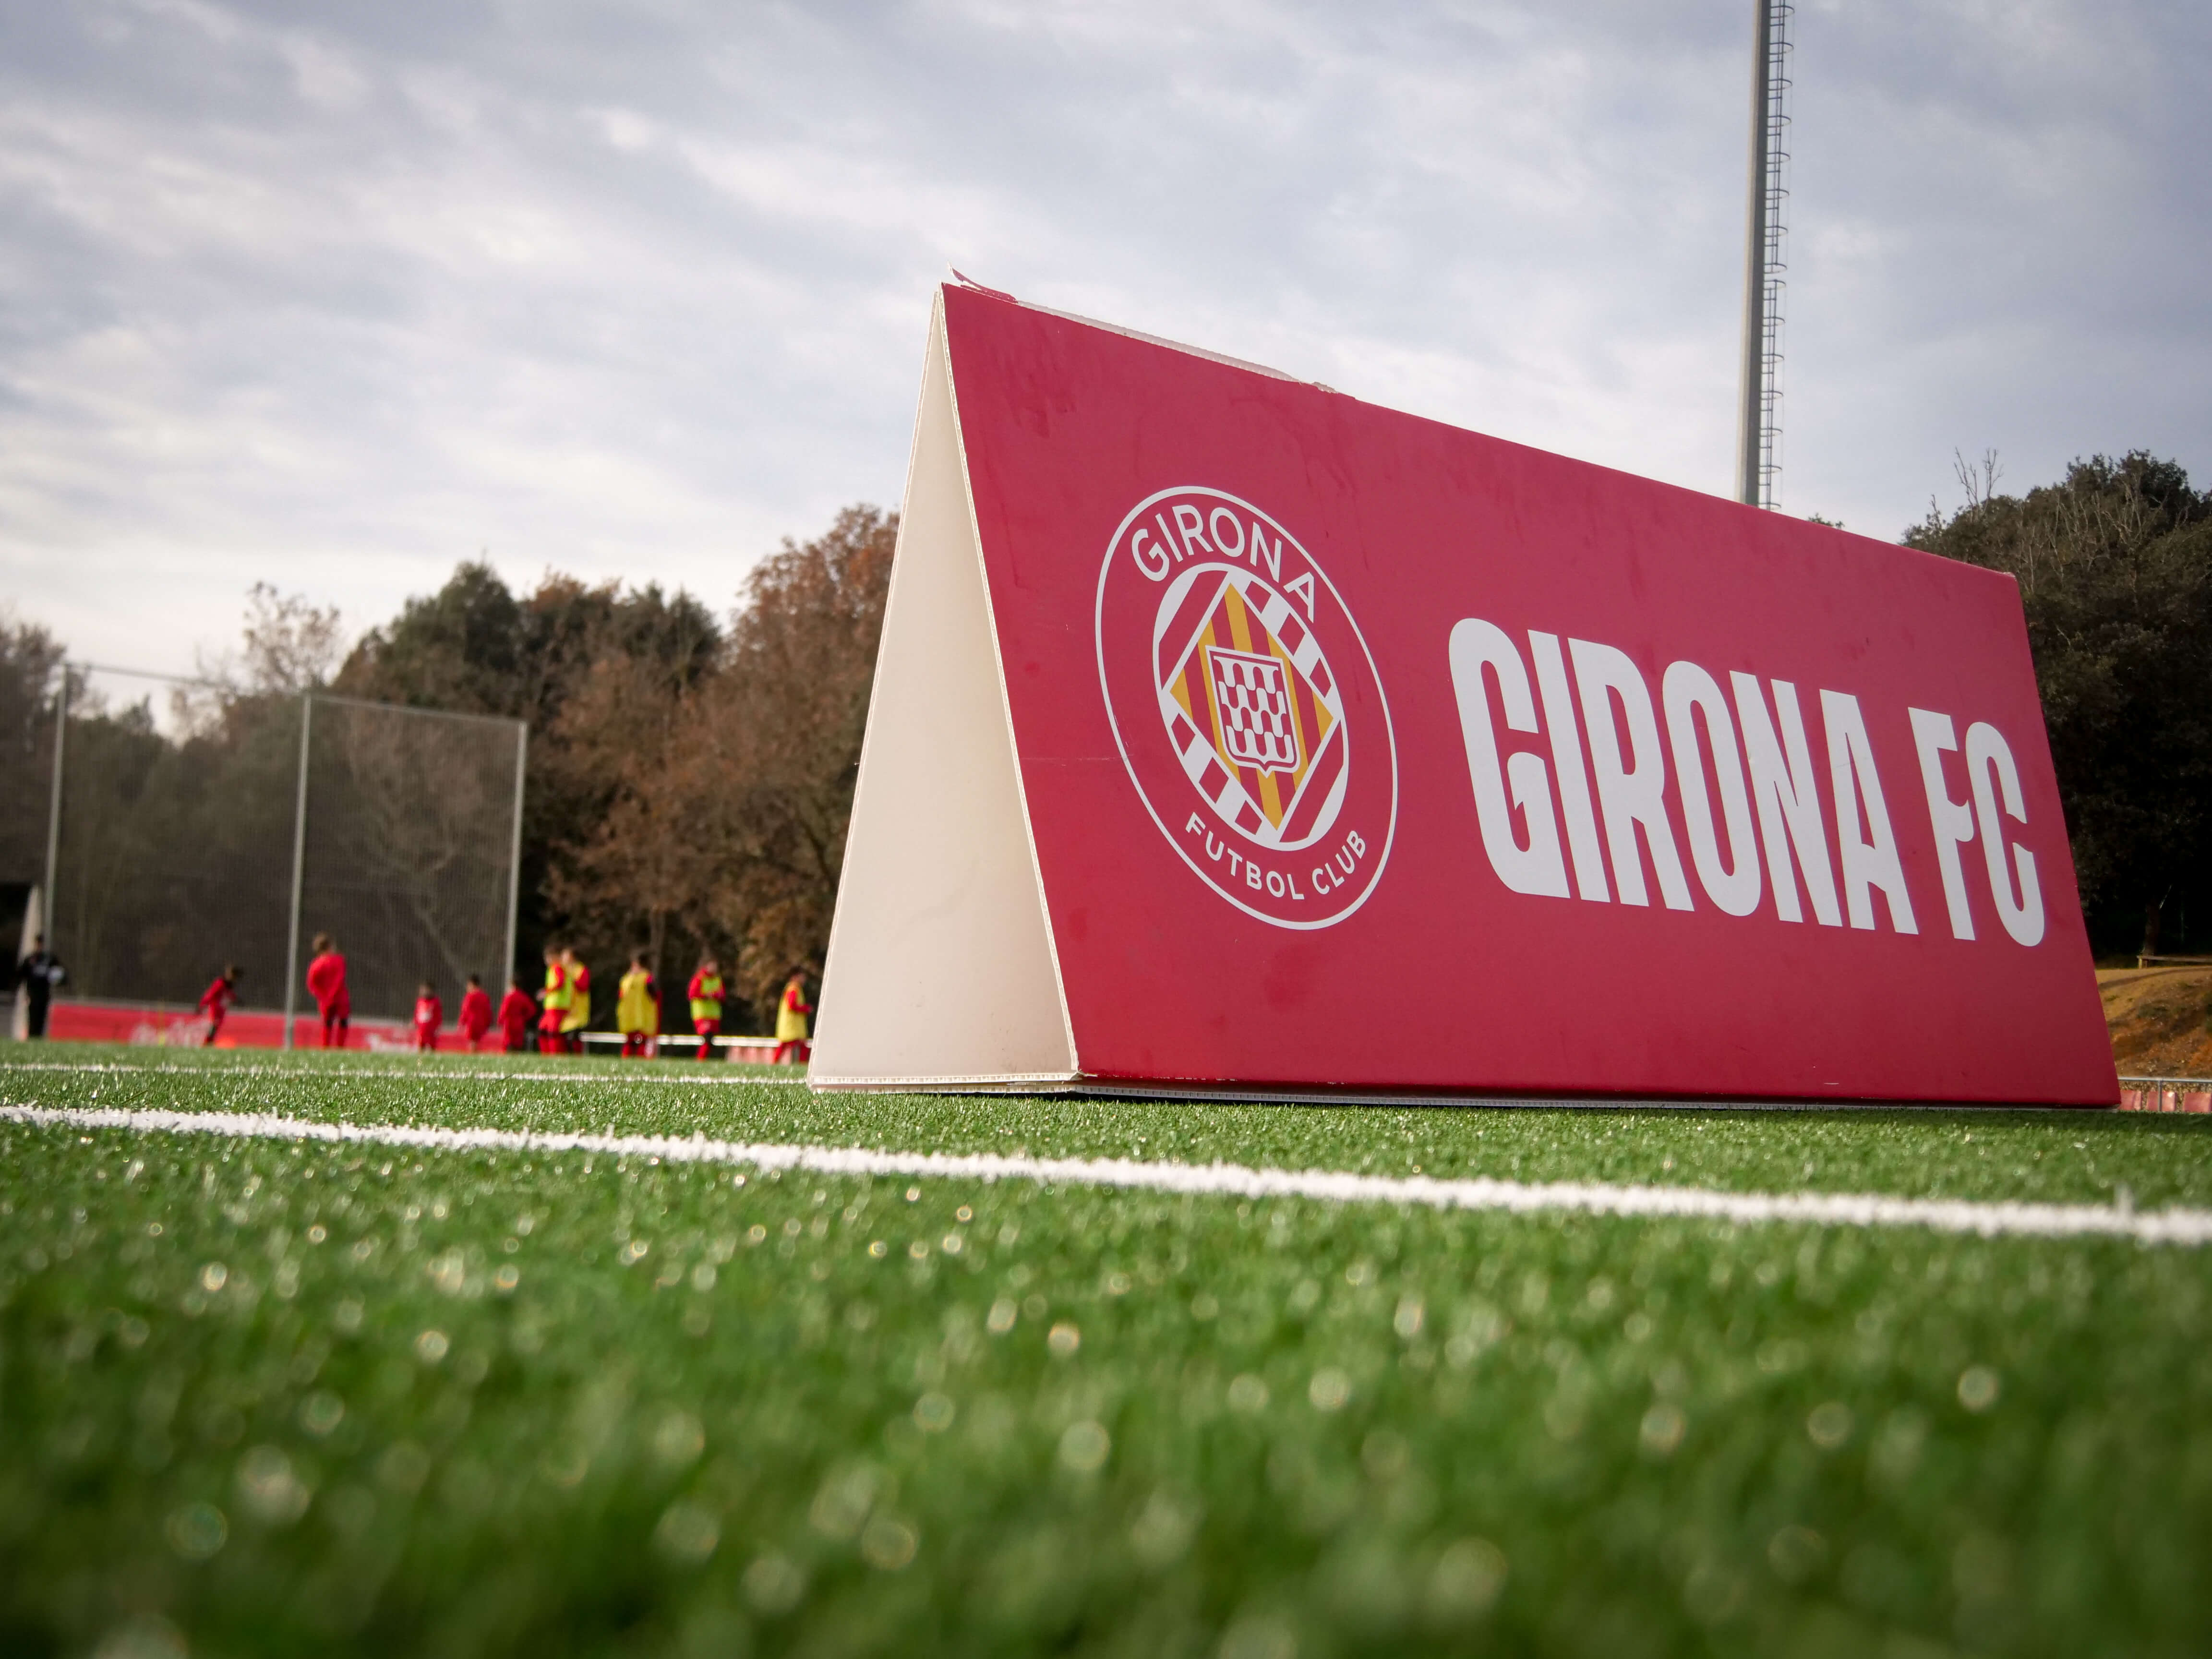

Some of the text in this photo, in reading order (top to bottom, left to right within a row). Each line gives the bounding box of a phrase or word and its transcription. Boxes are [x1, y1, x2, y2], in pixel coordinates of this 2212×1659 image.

[1131, 504, 1315, 623] GIRONA
[1449, 618, 2044, 946] GIRONA FC
[1185, 812, 1366, 900] FUTBOL CLUB
